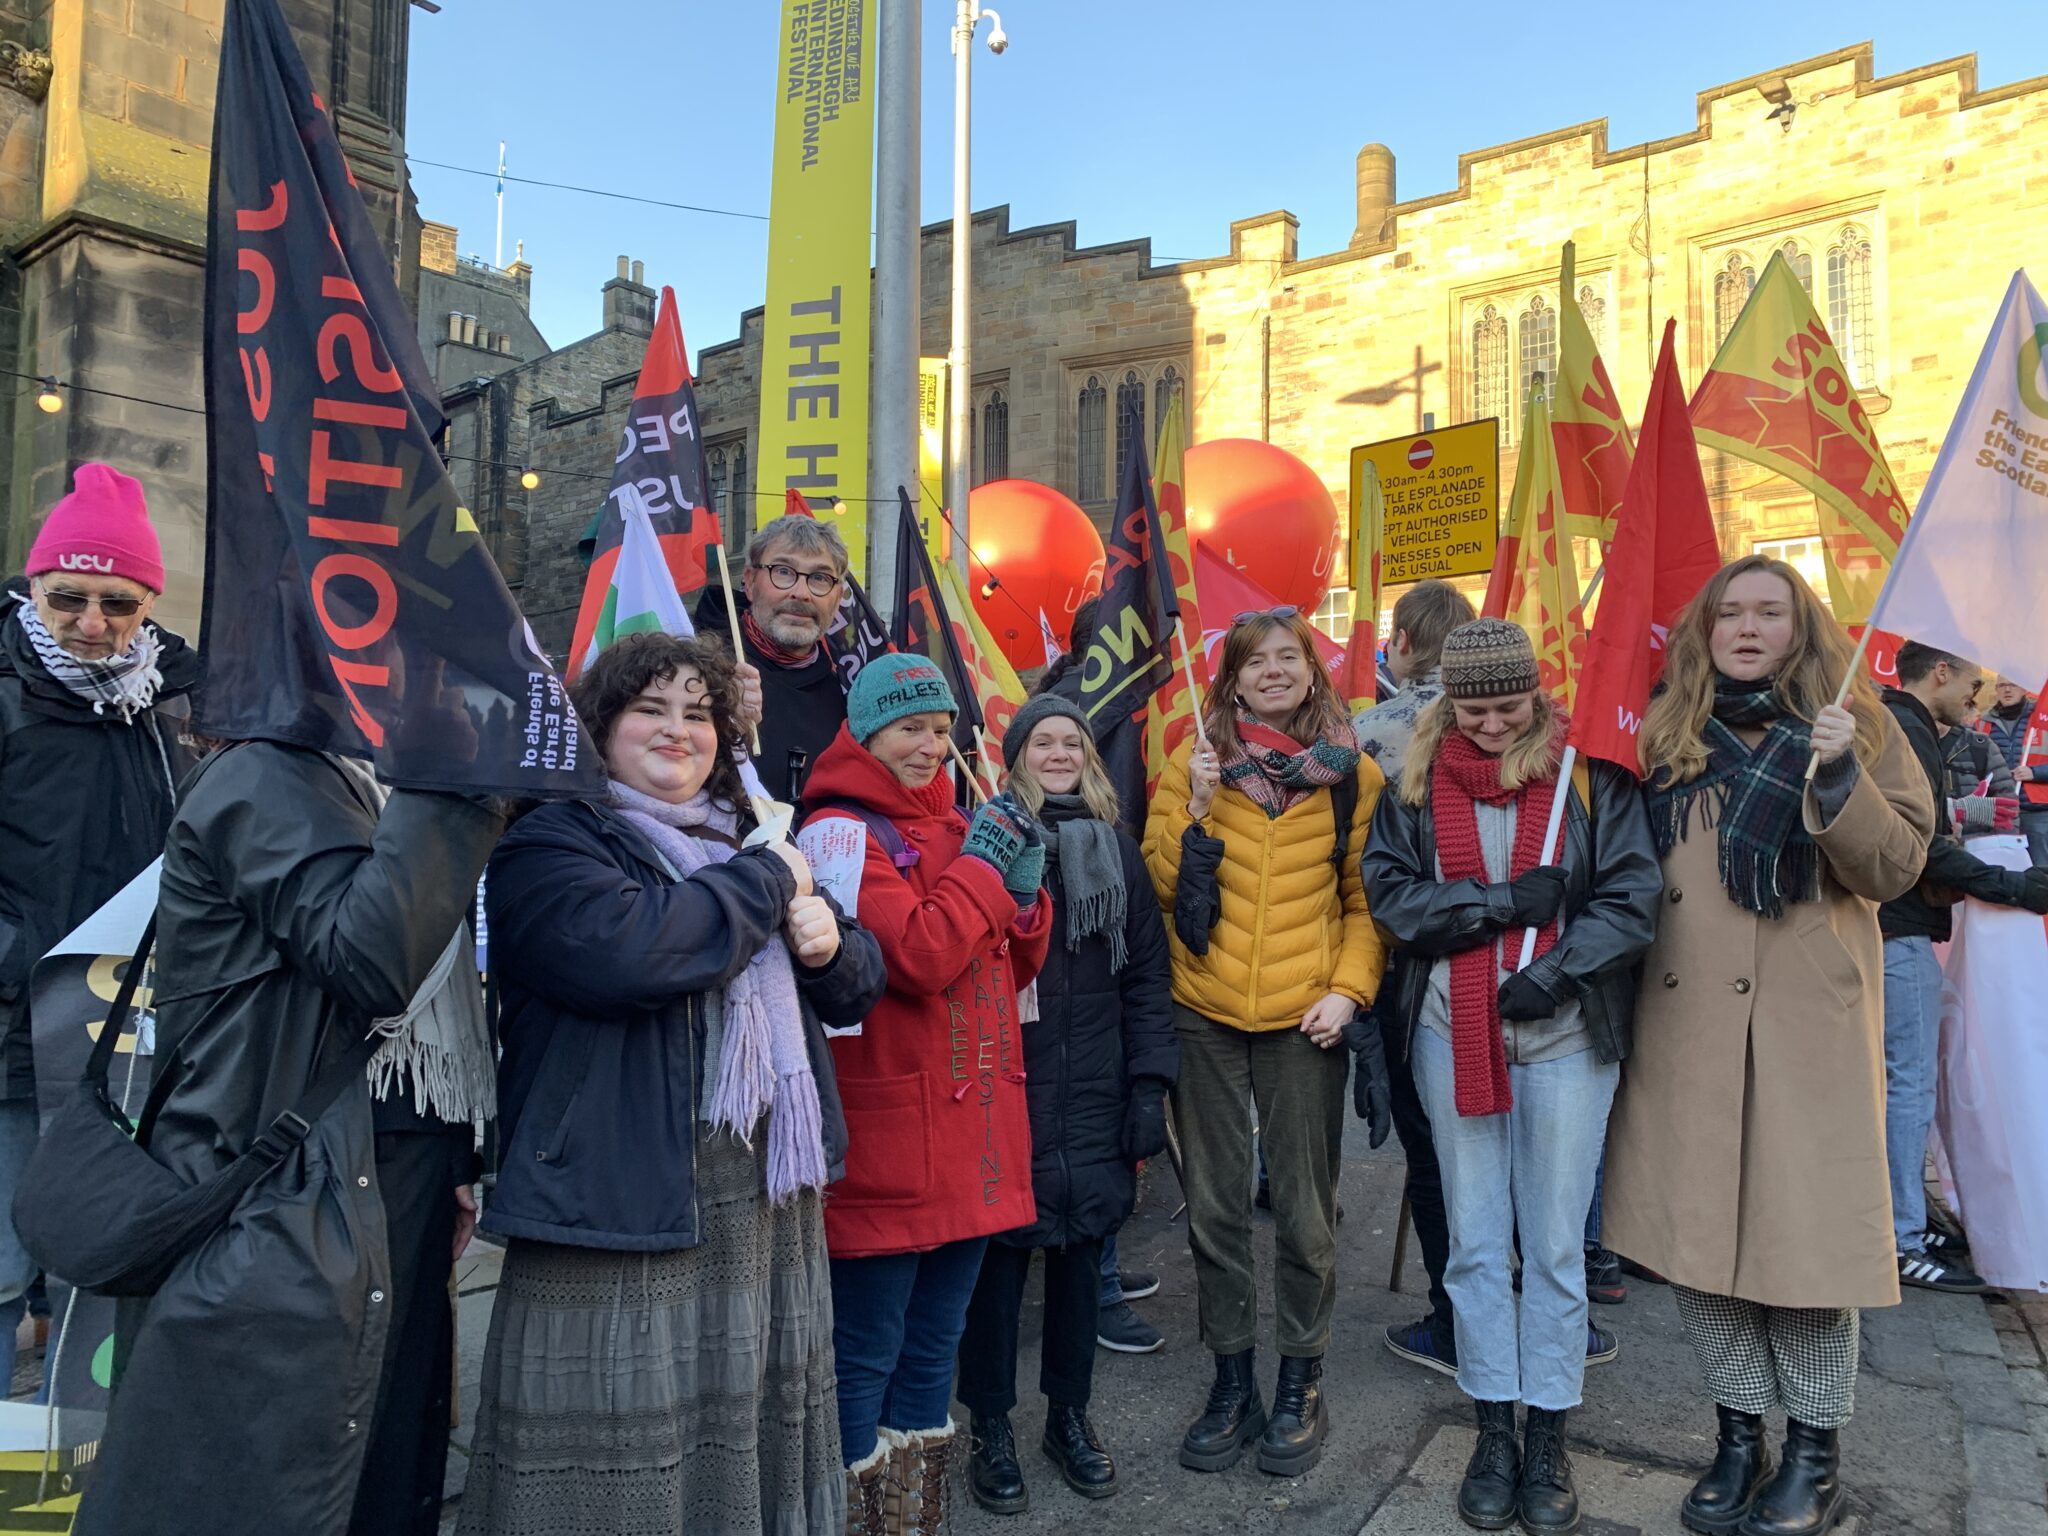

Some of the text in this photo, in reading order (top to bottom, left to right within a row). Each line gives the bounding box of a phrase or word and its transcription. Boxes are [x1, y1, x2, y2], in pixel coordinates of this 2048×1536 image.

[787, 4, 809, 104] FESTIVAL
[822, 0, 845, 122] EDINBURGH
[844, 0, 861, 103] OGETHER WE ARE
[801, 0, 827, 172] INTERNATIONAL
[787, 284, 842, 422] THE
[1984, 430, 2016, 457] the
[1427, 465, 1473, 480] 4.30pm
[1976, 449, 2048, 498] Scotla
[1409, 476, 1486, 501] ESPLANADE
[1392, 502, 1423, 517] PARK
[1429, 491, 1481, 510] CLOSED
[1405, 508, 1488, 531] AUTHORISED
[1391, 528, 1450, 547] VEHICLES
[1446, 541, 1482, 556] OPEN
[1389, 559, 1452, 578] AS USUAL
[969, 957, 1000, 1206] PALESTINE
